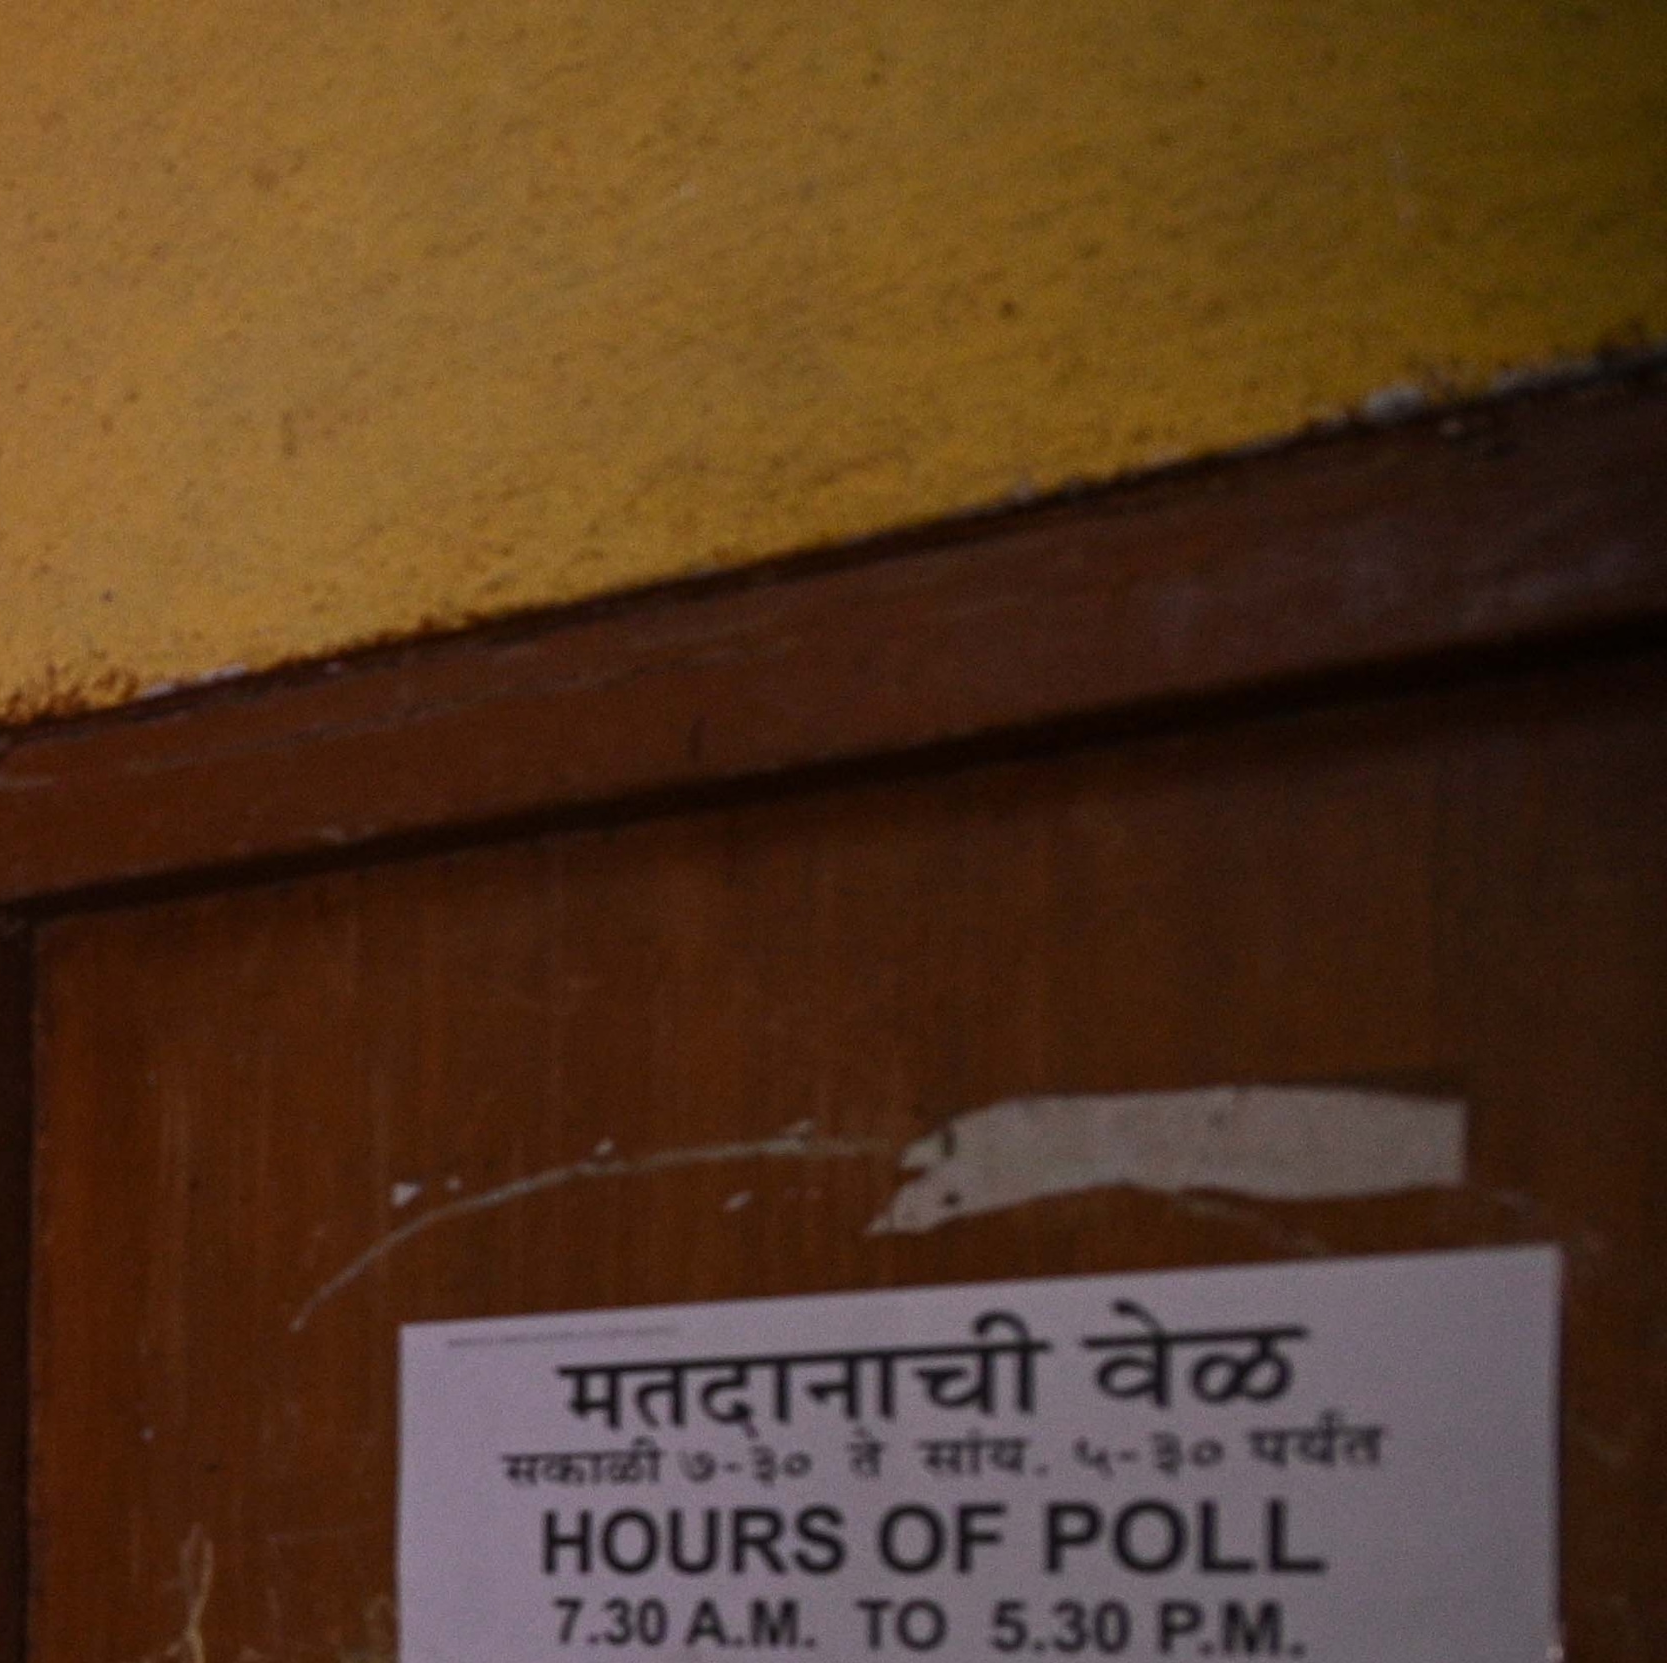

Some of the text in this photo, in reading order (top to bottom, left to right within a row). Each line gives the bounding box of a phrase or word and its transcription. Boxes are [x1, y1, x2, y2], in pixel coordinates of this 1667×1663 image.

[557, 1300, 1308, 1438] मतदानाची वेळ
[503, 1436, 662, 1485] सकाळी
[847, 1428, 881, 1476] ते
[543, 1500, 1328, 1575] HOURS OF POLL
[555, 1599, 1306, 1657] 7.30 A.M. TO 5.30 P.M.
